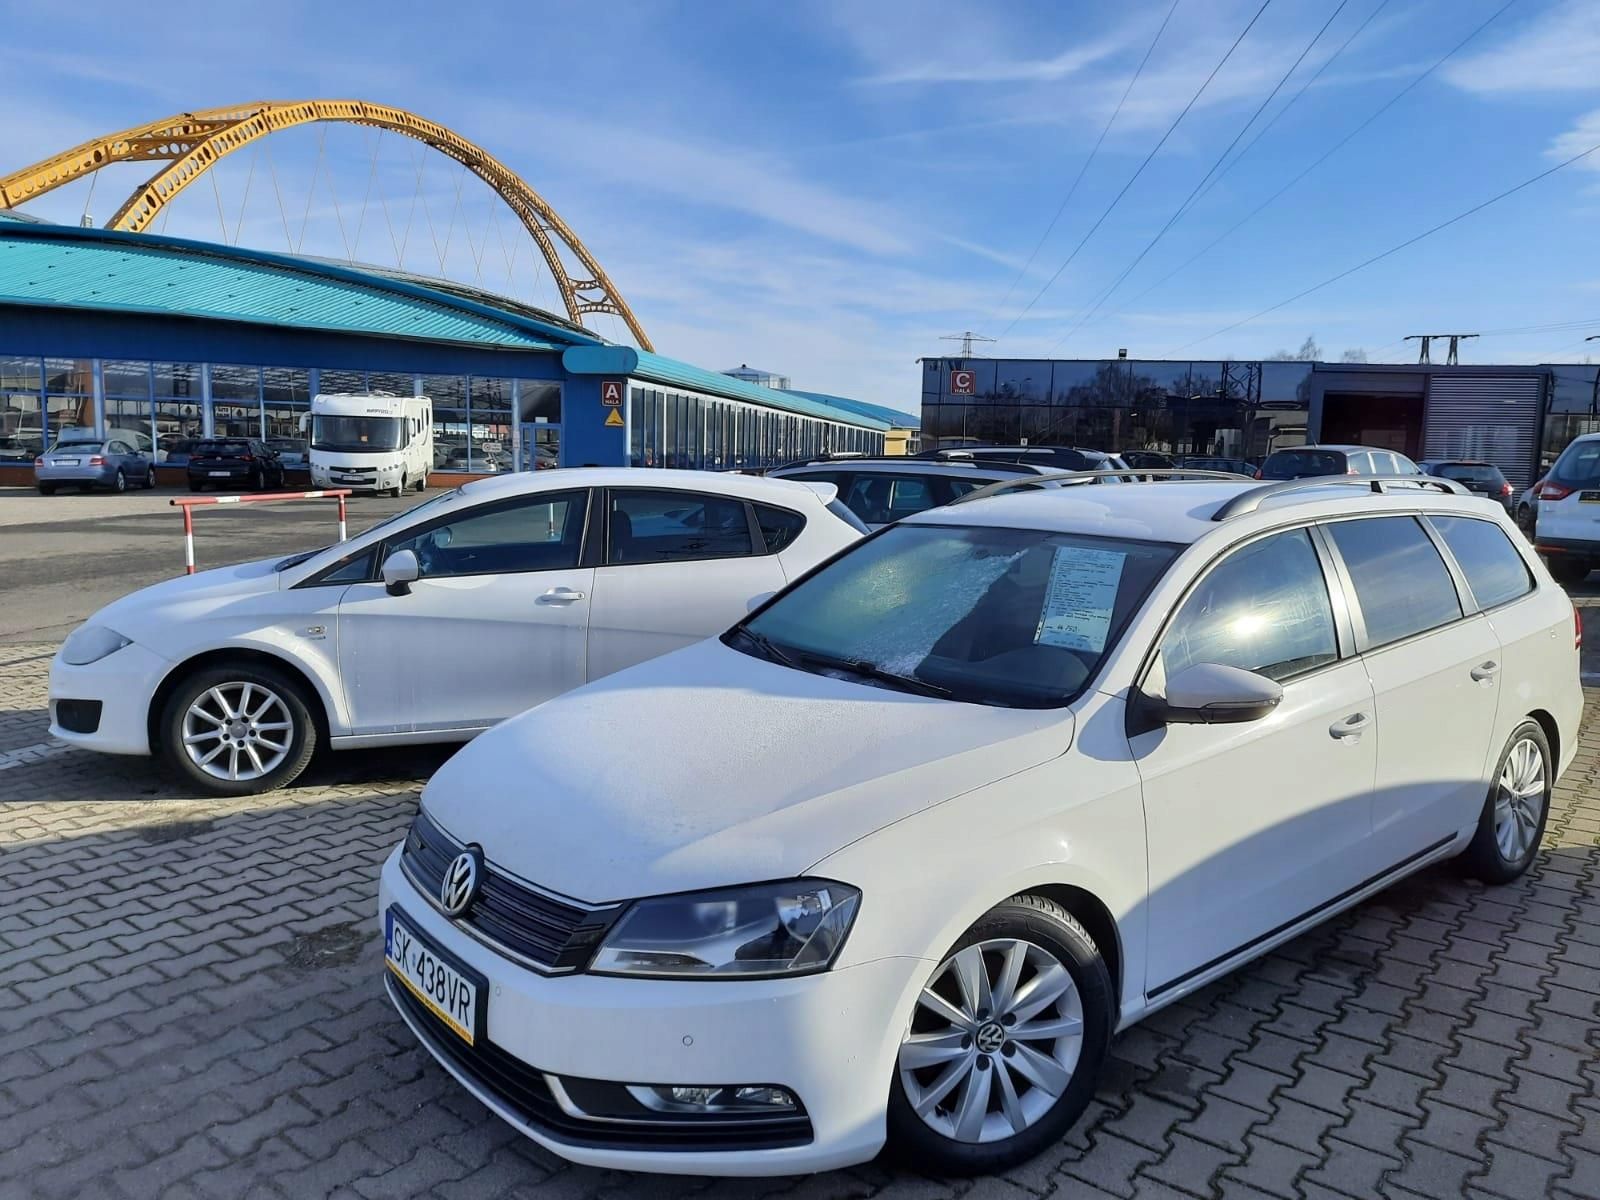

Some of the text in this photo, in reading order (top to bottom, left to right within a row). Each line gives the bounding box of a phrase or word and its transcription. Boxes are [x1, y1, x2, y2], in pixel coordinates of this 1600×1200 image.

[956, 373, 970, 387] C
[605, 384, 619, 398] A
[394, 927, 411, 974] SK
[416, 951, 471, 1027] 438VR
